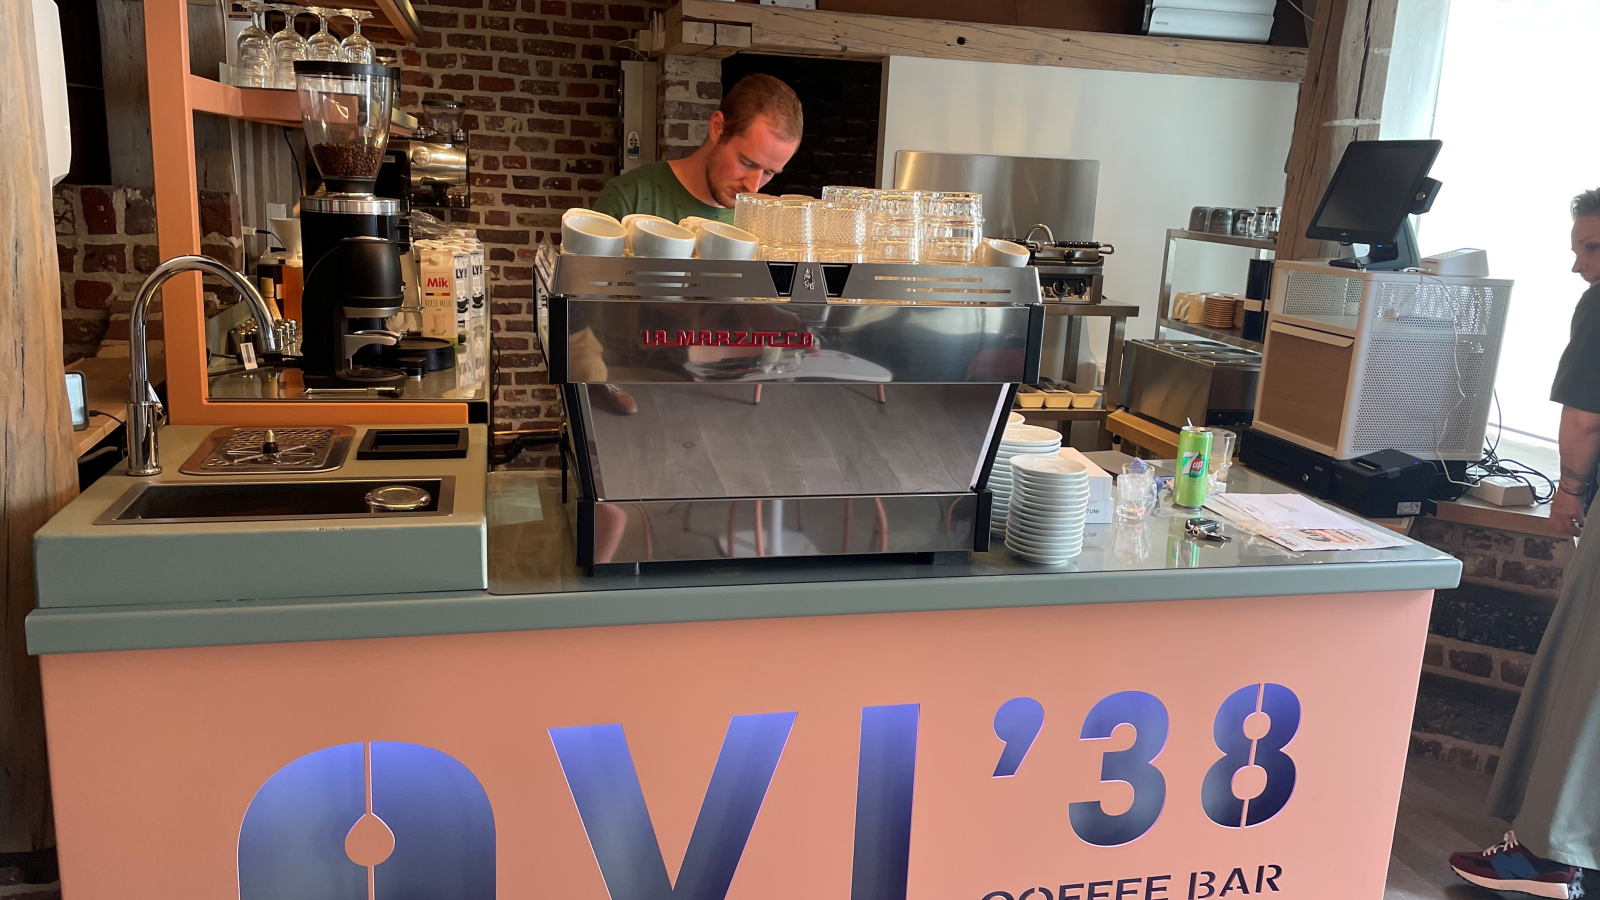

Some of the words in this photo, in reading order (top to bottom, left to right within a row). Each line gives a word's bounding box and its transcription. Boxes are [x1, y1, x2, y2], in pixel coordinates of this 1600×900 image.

[456, 268, 467, 279] LY!
[472, 265, 482, 276] LY!
[427, 278, 448, 288] Mik
[643, 330, 667, 346] LA
[1187, 864, 1284, 900] BAR
